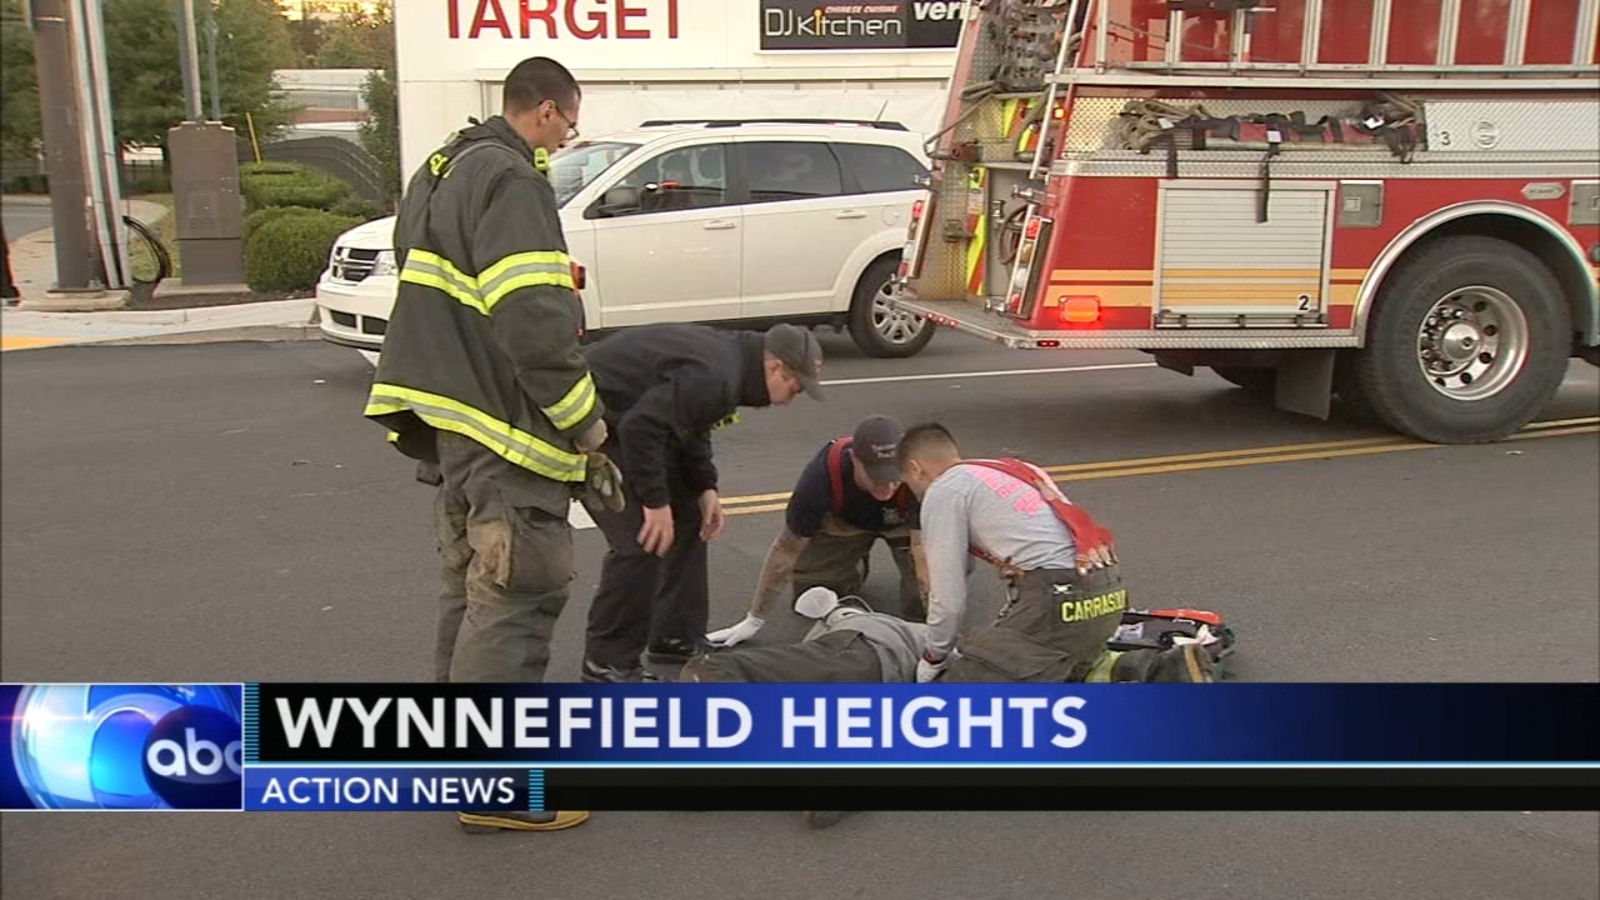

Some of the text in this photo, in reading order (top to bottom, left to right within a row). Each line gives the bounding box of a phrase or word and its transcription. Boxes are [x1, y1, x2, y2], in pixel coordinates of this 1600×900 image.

[446, 0, 679, 40] TARGET
[1441, 131, 1451, 146] 3
[1299, 295, 1310, 311] 2
